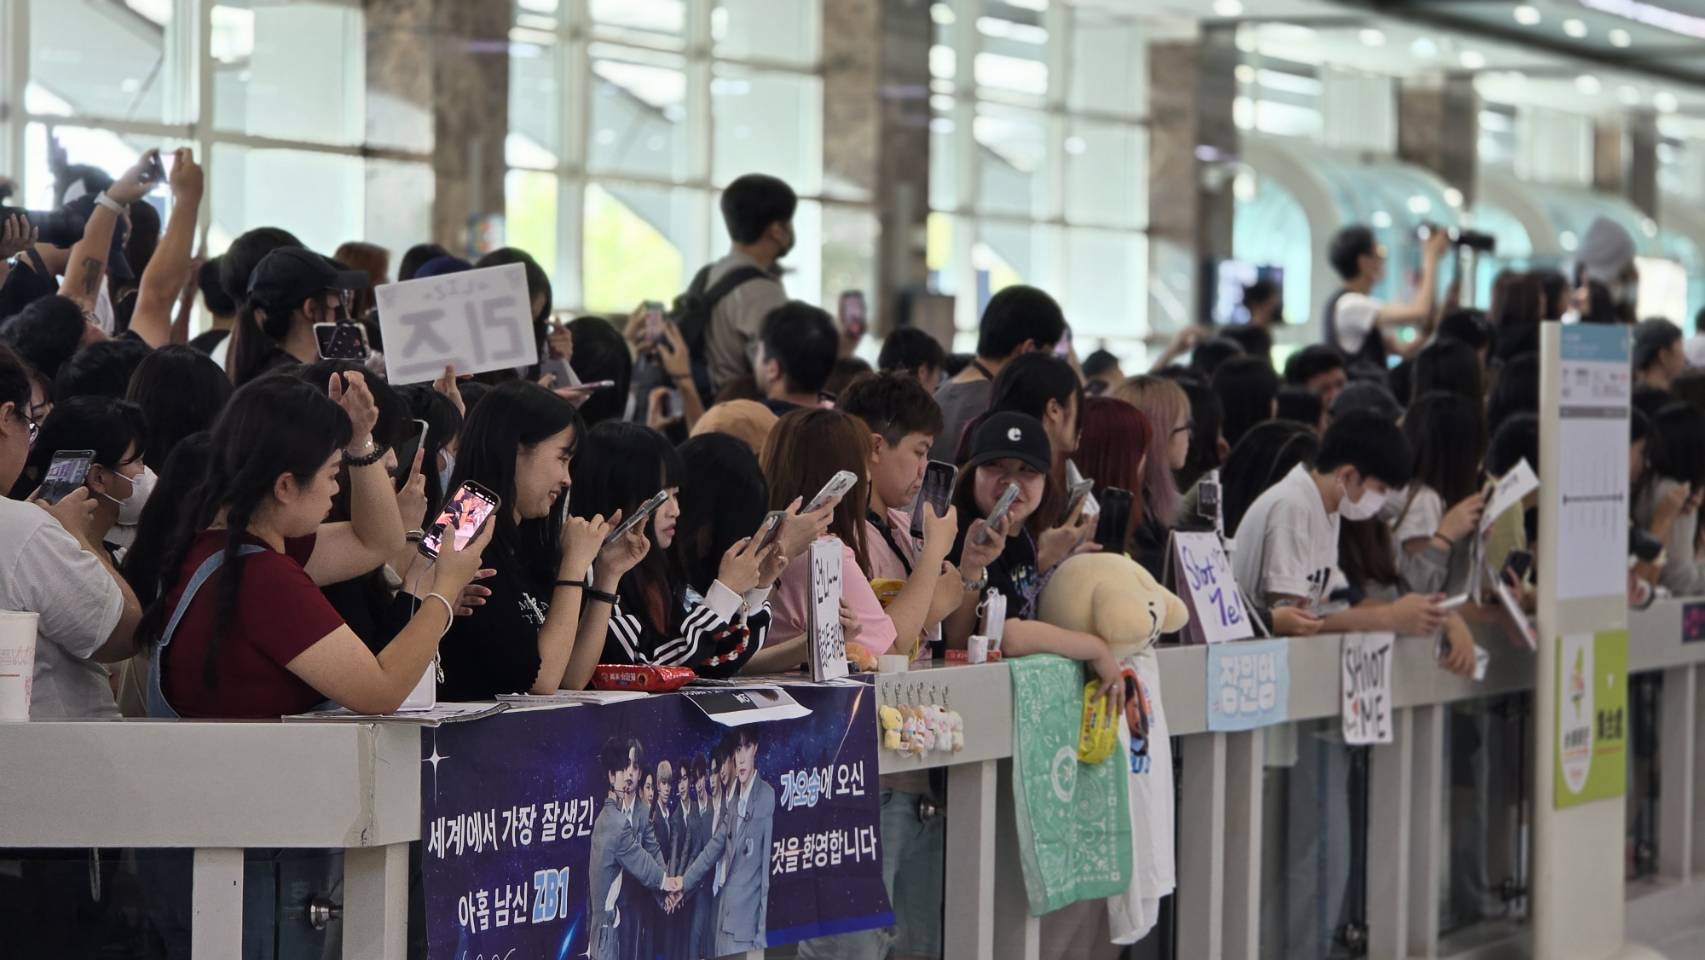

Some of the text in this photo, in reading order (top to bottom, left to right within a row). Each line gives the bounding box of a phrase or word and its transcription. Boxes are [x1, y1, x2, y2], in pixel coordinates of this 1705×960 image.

[1220, 654, 1276, 715] 장원영
[780, 760, 865, 811] 가오슝에 오신
[427, 796, 593, 859] 세계에서 가장 잘생긴
[772, 825, 877, 875] 것을 환영합니다
[458, 866, 570, 934] 아홉 남신 ZB1
